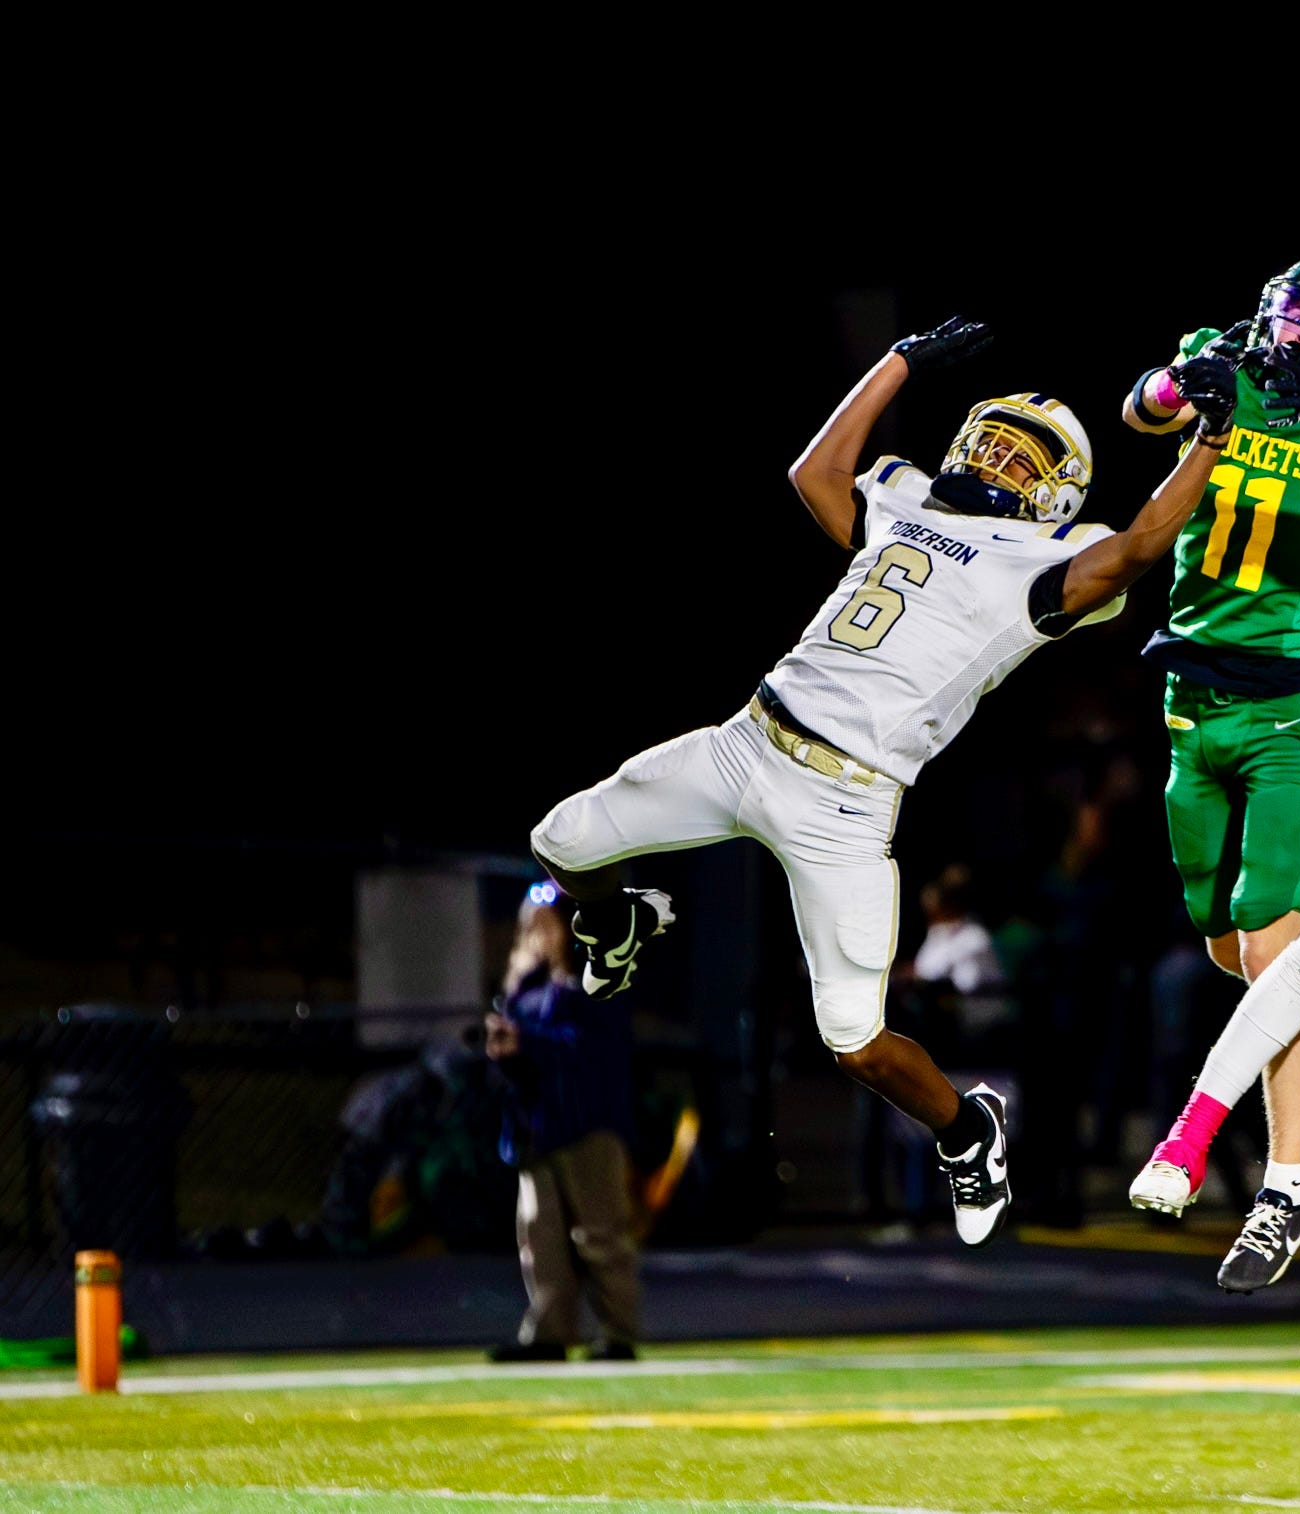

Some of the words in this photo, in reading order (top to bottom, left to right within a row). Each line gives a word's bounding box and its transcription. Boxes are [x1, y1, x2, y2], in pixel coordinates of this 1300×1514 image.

[886, 520, 980, 567] ROBERSON
[1200, 463, 1288, 593] 11
[827, 541, 934, 652] 6
